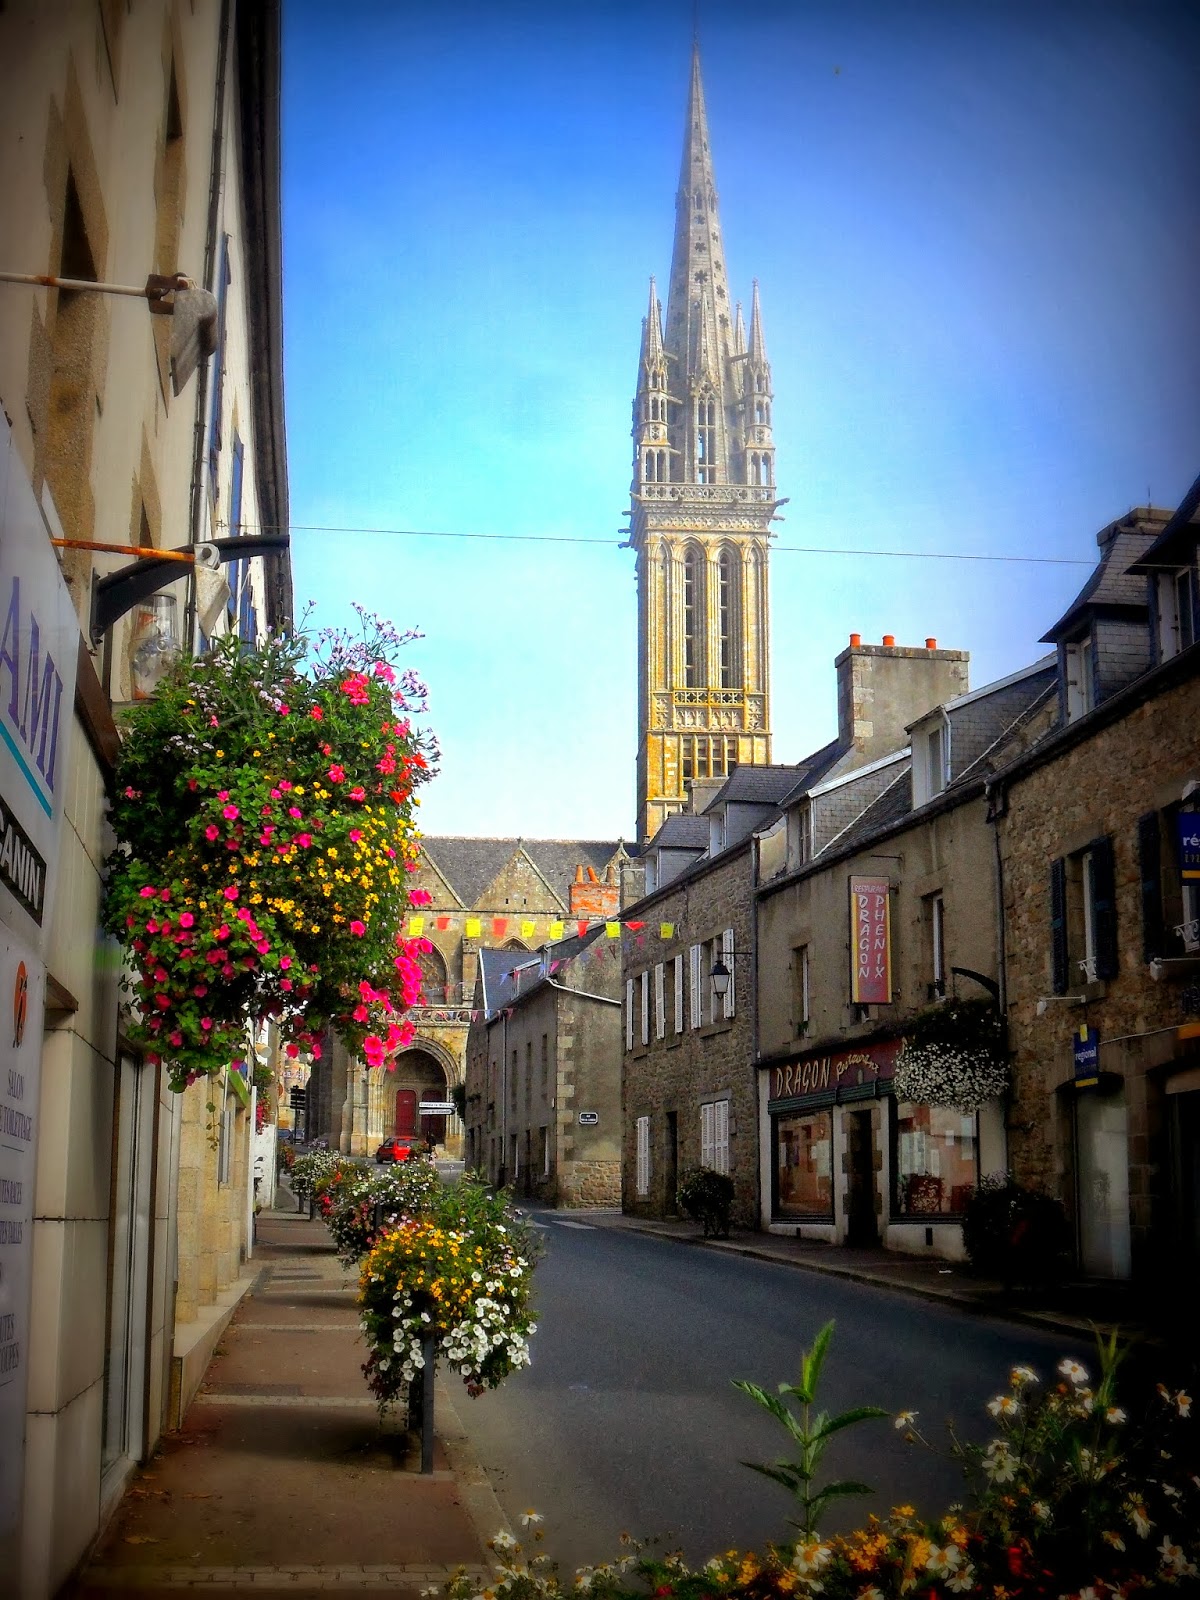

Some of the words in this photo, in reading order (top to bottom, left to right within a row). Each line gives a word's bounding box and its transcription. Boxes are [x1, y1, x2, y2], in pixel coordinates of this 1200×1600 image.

[858, 895, 870, 979] DRAGON
[875, 895, 885, 979] PHENIX
[7, 1068, 24, 1101] SALON
[776, 1055, 831, 1098] DRAGON
